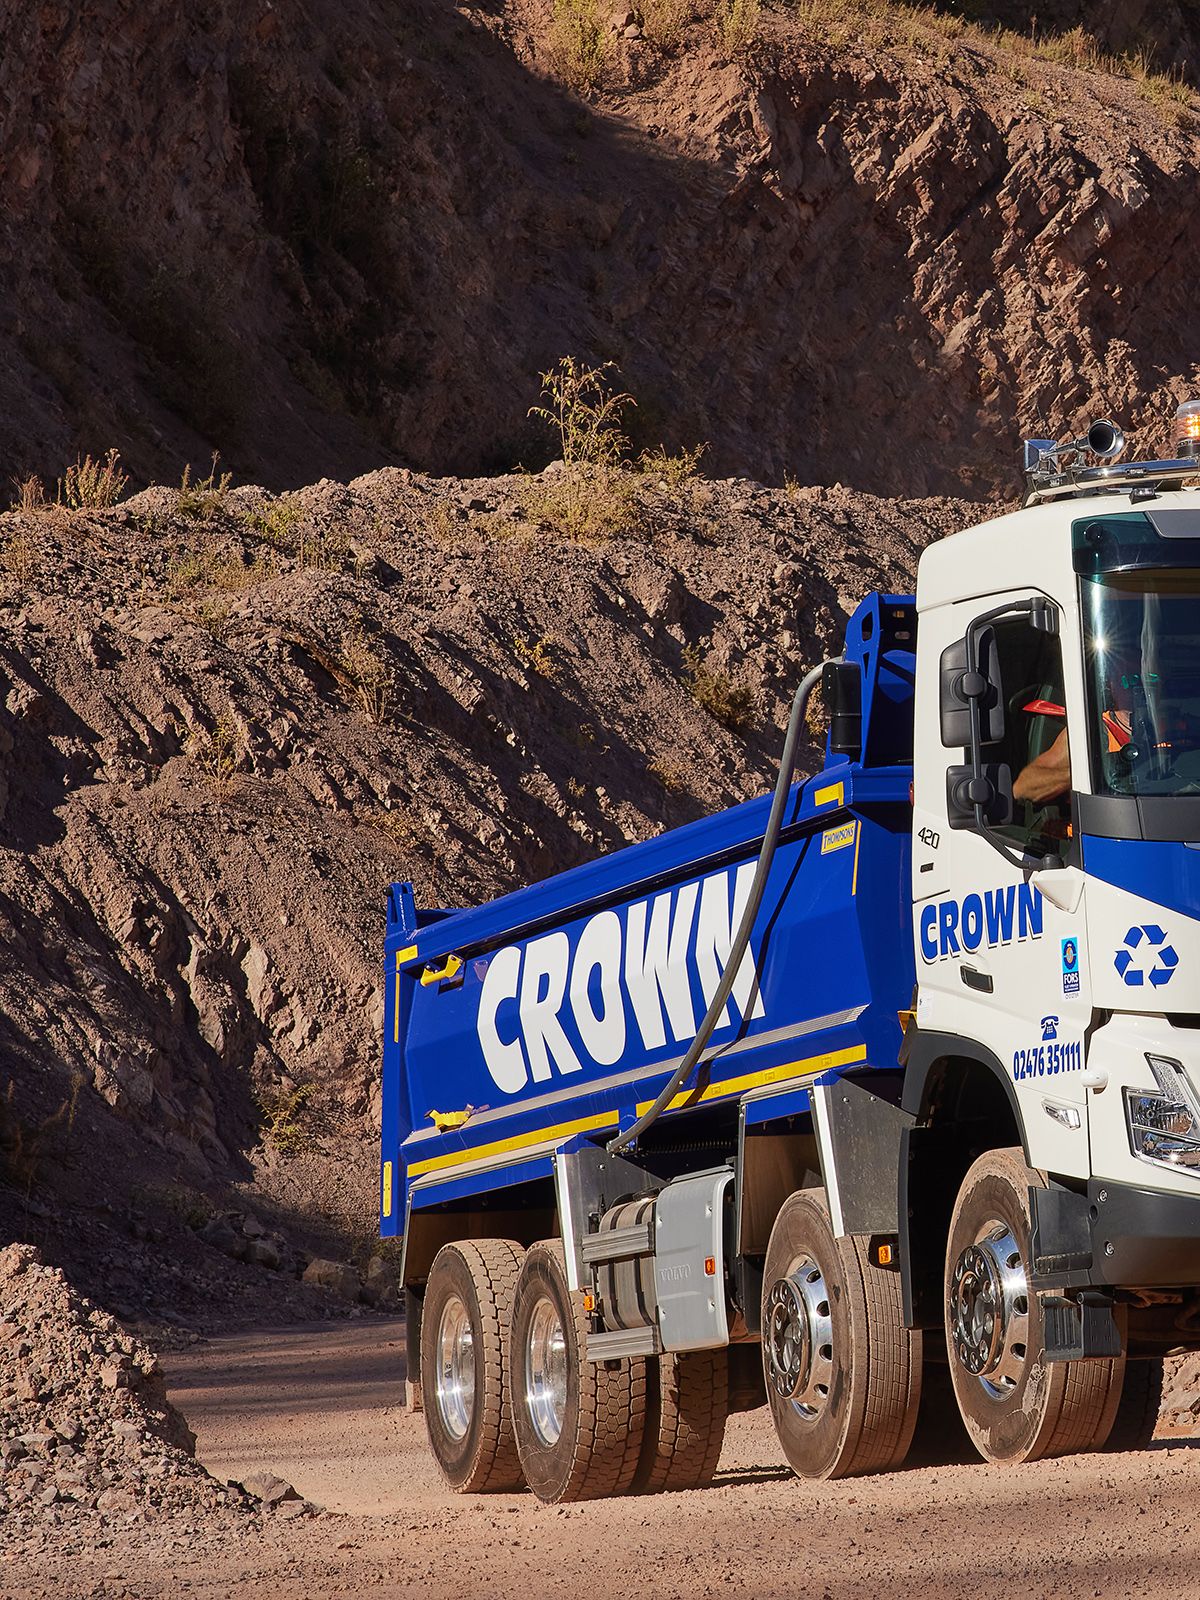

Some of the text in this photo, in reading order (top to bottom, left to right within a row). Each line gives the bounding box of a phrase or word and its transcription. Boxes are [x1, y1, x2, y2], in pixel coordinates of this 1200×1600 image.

[918, 827, 940, 849] 420
[920, 882, 1043, 964] CROWN
[477, 860, 767, 1094] CROWN
[1064, 973, 1079, 985] FORS
[1013, 1040, 1081, 1081] 02476 351111
[659, 1263, 692, 1281] VOLVO
